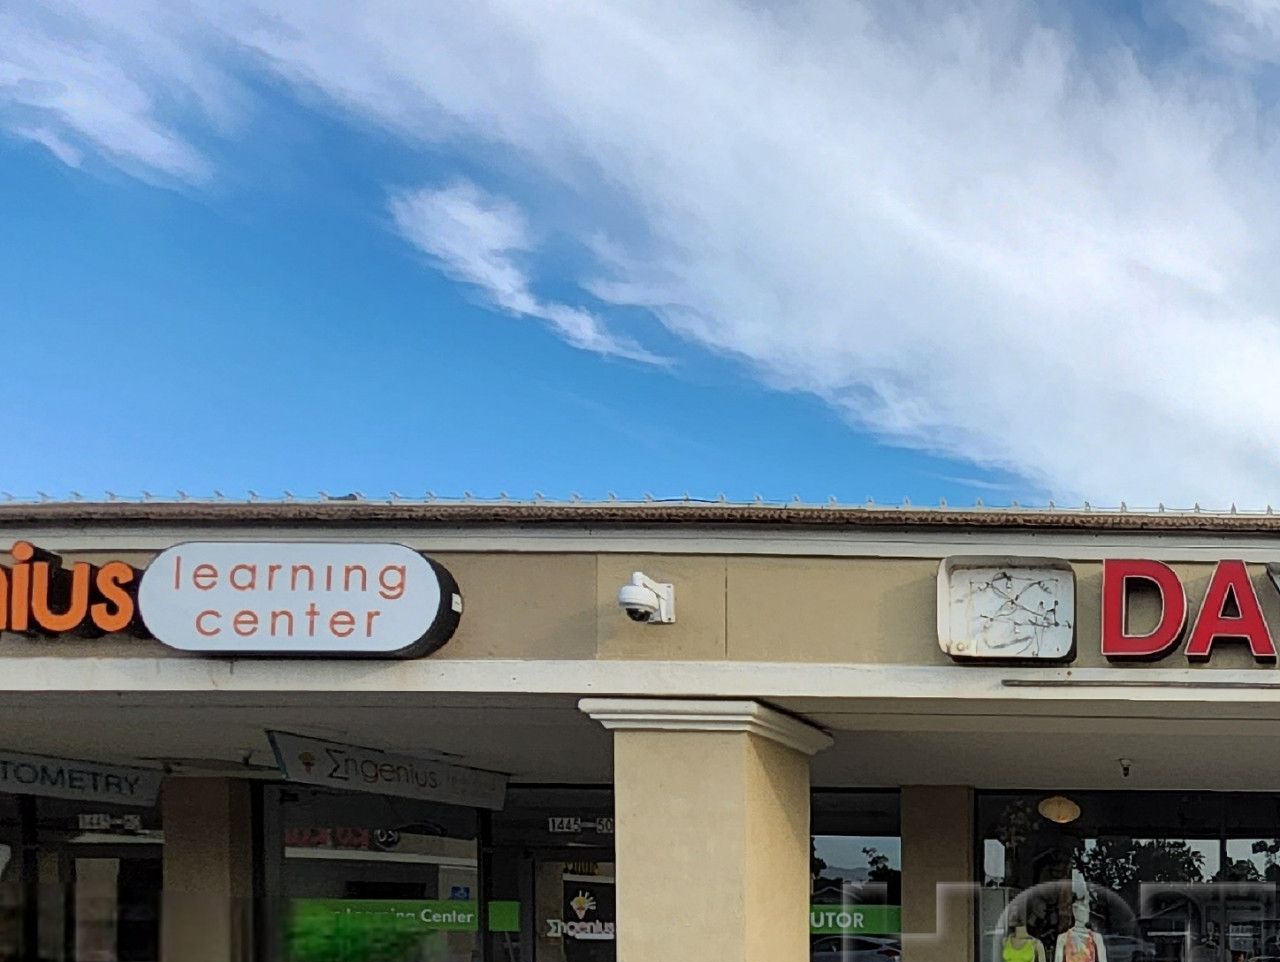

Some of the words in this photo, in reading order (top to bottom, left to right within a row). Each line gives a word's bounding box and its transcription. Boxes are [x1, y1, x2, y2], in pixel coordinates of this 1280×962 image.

[0, 541, 134, 632] ius
[174, 556, 407, 600] learning
[195, 603, 381, 639] center
[420, 908, 474, 923] Center
